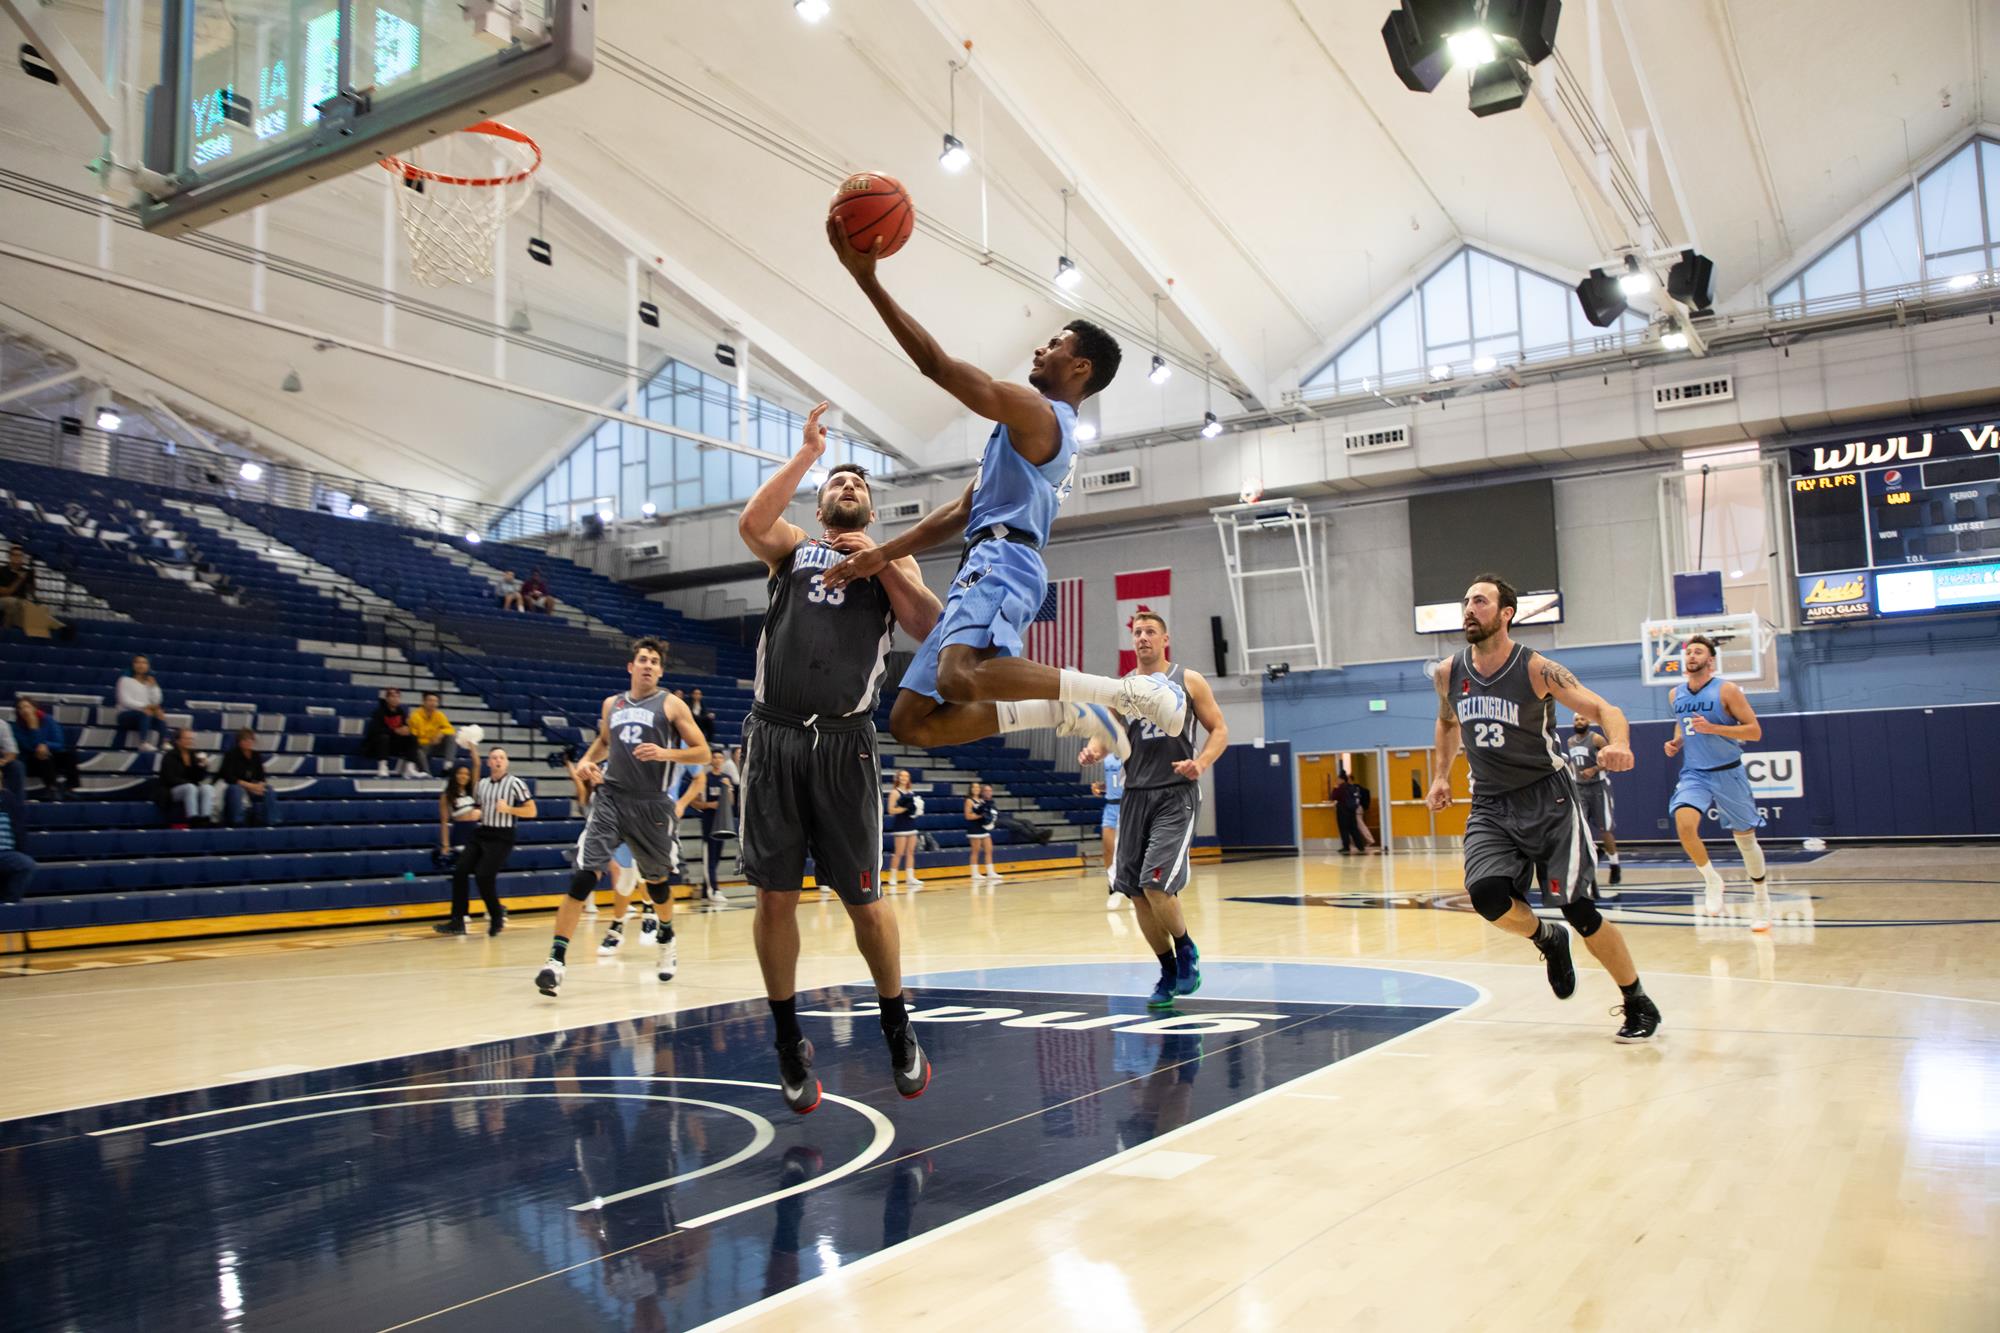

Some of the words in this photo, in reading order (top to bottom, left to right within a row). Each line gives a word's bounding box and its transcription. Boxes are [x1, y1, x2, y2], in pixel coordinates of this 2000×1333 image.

[1813, 432, 1933, 471] WWU
[1959, 424, 2000, 451] VI
[1834, 474, 1856, 487] PTS
[1950, 490, 1979, 501] PERIOD
[1879, 530, 1898, 540] WON
[1949, 522, 1969, 532] LAST
[1969, 521, 1985, 530] SET
[807, 574, 846, 605] 33
[1807, 605, 1835, 617] AUTO
[1836, 603, 1868, 615] GLASS
[1456, 695, 1520, 726] BELLINGHAM
[1675, 701, 1714, 714] WWU
[619, 725, 643, 744] 42
[1140, 718, 1166, 740] 22
[1474, 723, 1505, 748] 23
[1683, 717, 1696, 736] 2
[1575, 755, 1585, 766] 11
[1745, 759, 1793, 782] CU
